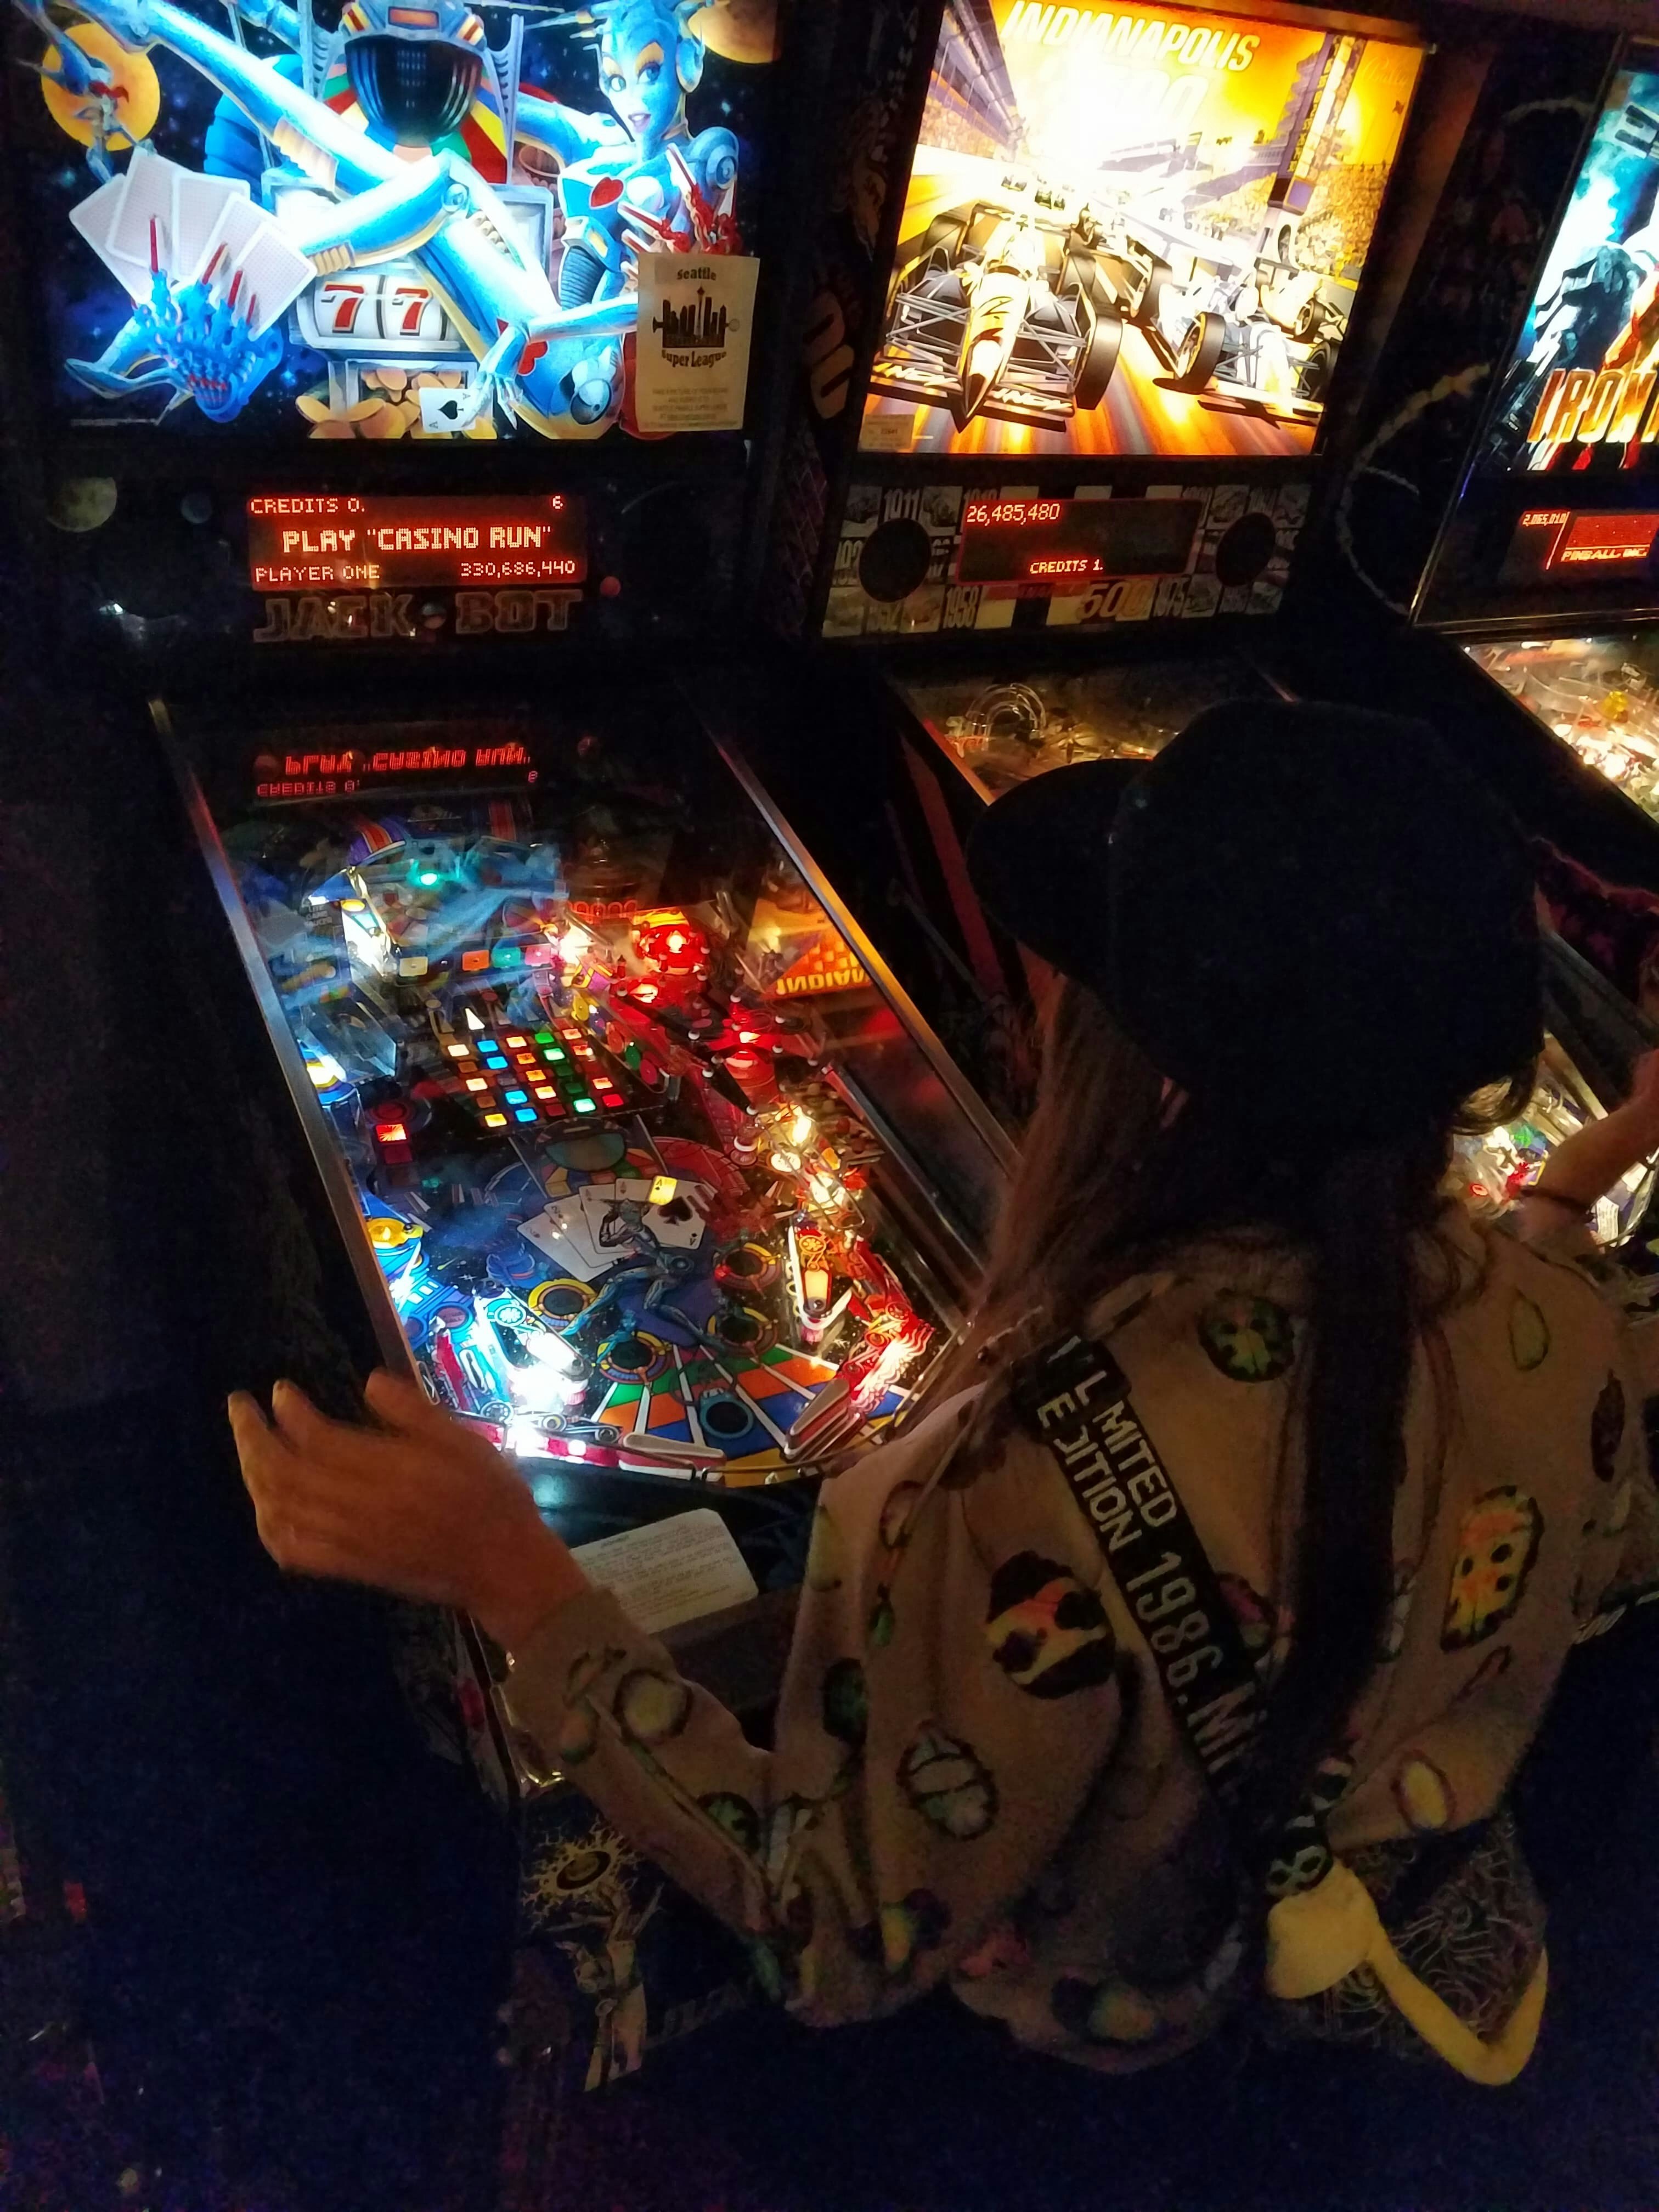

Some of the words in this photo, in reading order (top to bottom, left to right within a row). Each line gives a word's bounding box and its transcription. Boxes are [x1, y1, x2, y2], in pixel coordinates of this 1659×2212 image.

[1000, 0, 1261, 72] INDIANAPOLIS
[1527, 368, 1657, 443] IRON
[251, 498, 338, 515] CREDITS
[966, 503, 1062, 527] 26,485,480
[283, 530, 356, 553] PLAY
[367, 527, 479, 551] "CASINO
[489, 525, 552, 548] RUN"
[255, 565, 334, 583] PLAYER
[343, 563, 381, 580] ONE
[461, 560, 576, 579] 330,686,440
[1029, 559, 1088, 575] CREDITS
[1074, 1369, 1178, 1529] LMITED
